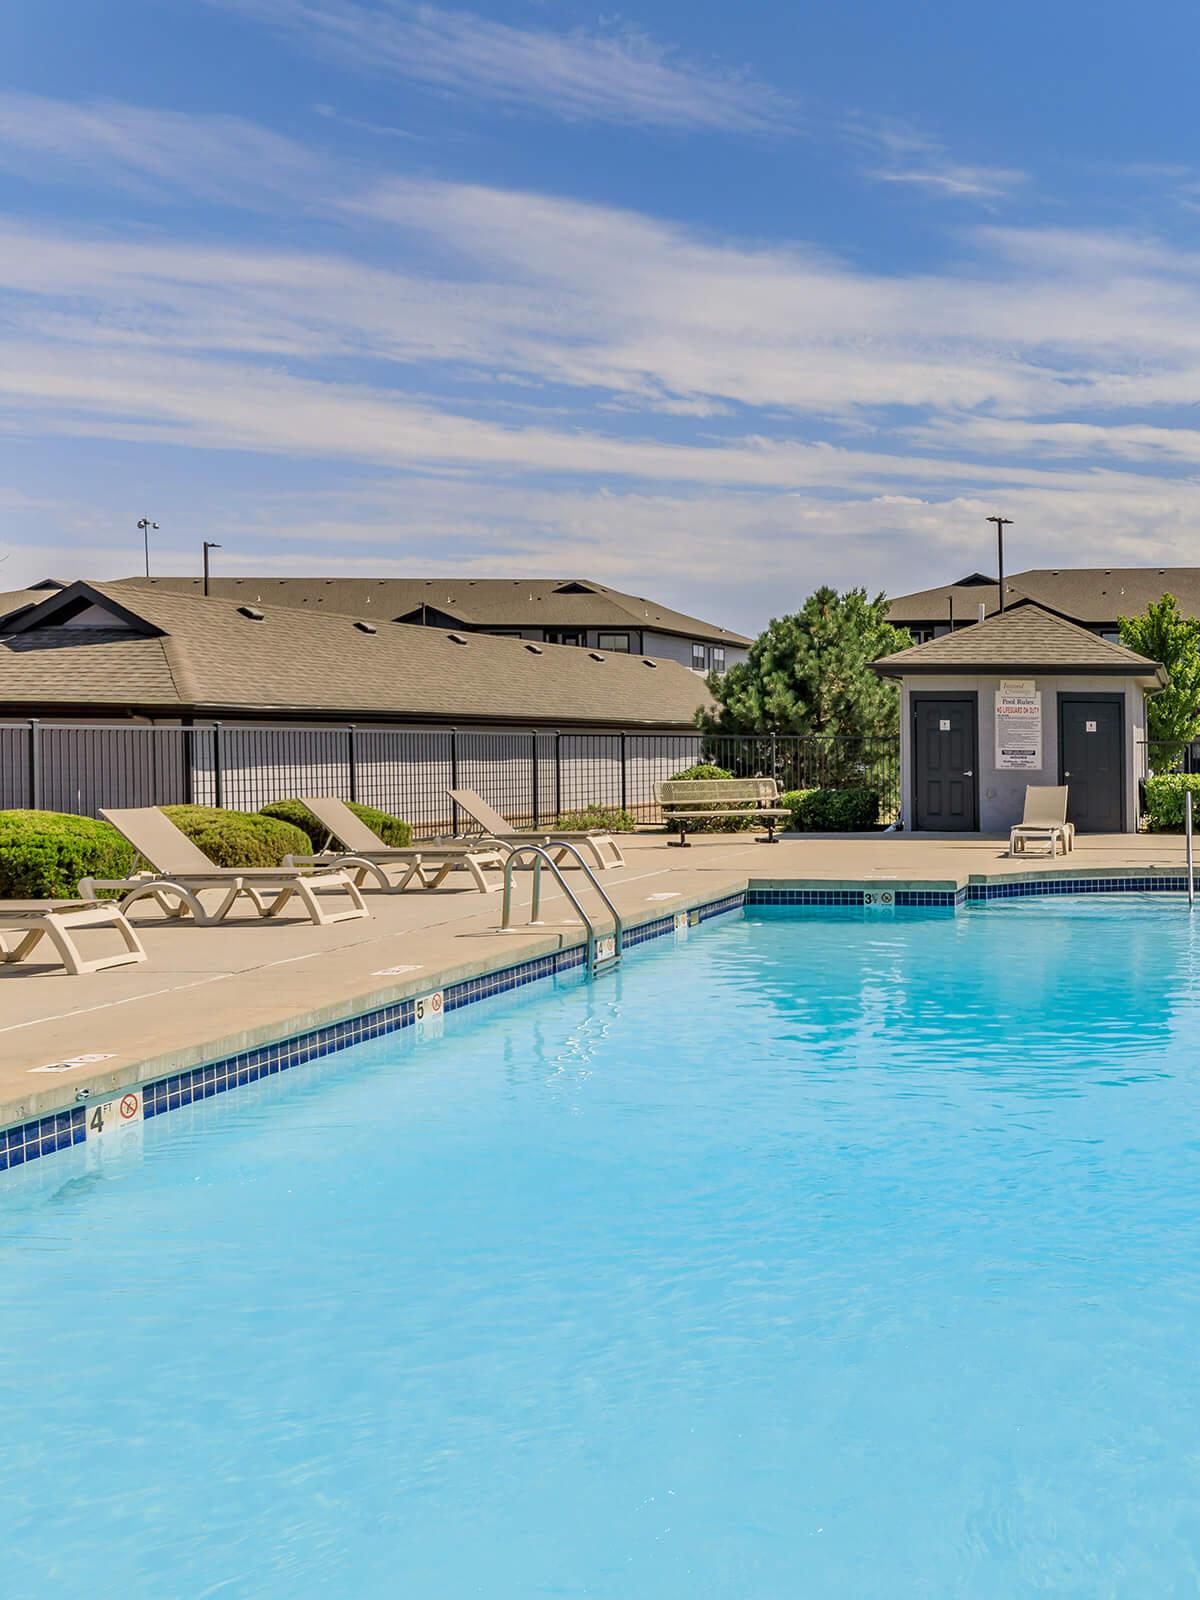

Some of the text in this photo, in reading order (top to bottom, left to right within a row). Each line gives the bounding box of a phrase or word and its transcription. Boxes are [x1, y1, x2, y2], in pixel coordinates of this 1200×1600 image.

[1002, 706, 1023, 714] LIFEGUARD
[1029, 706, 1040, 714] DUTY
[416, 1000, 424, 1019] 5
[90, 1105, 104, 1133] 4
